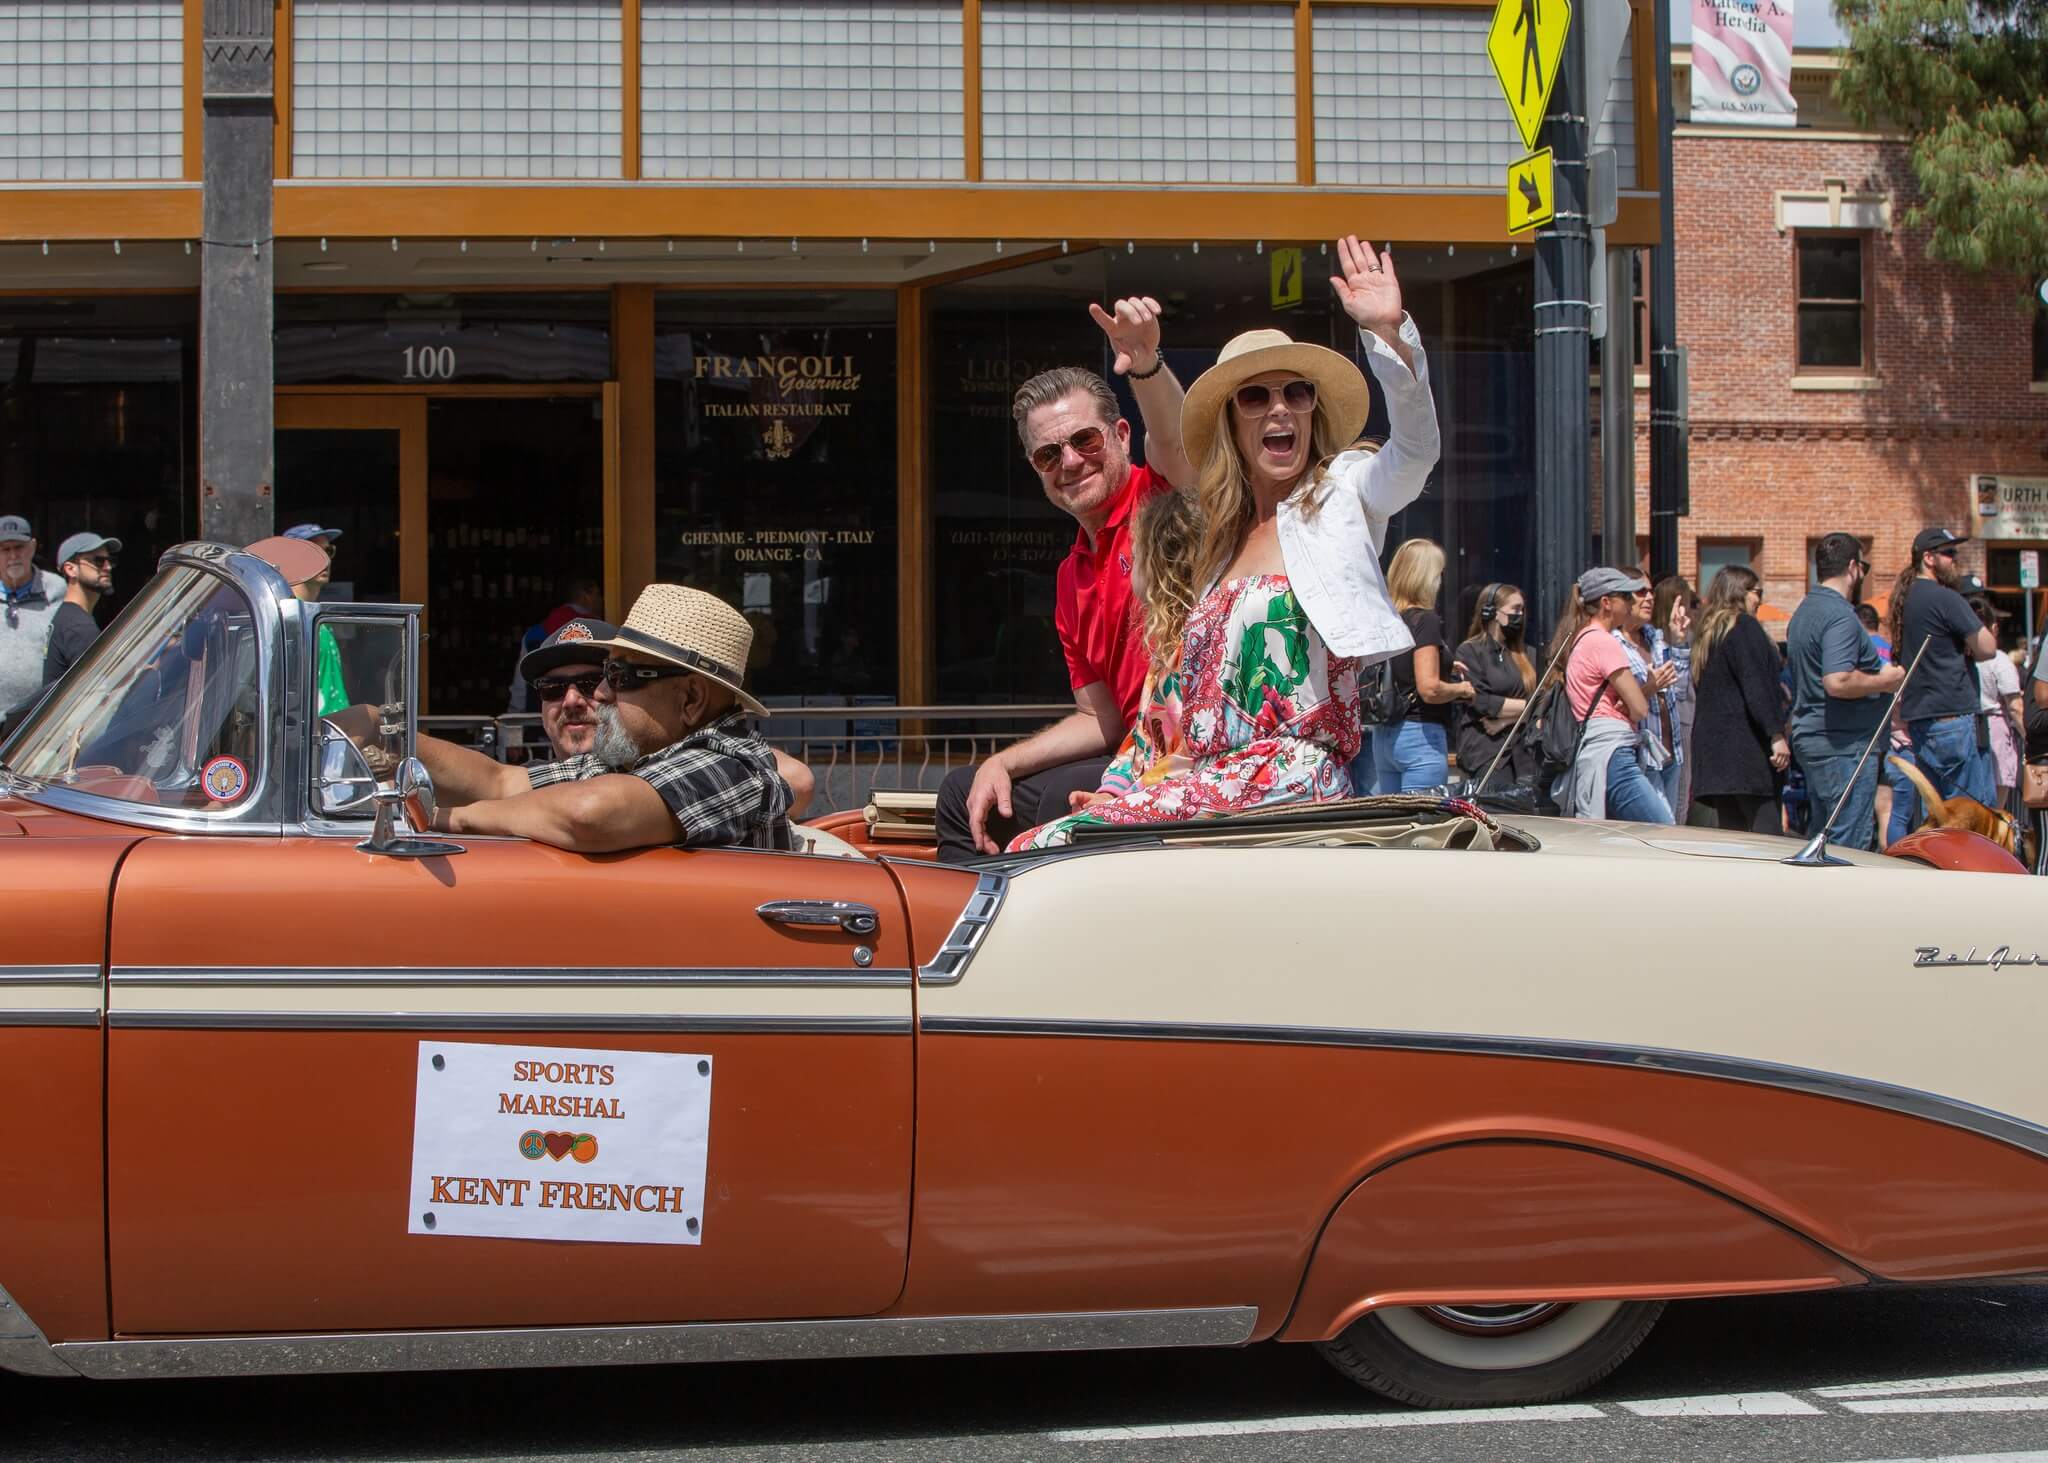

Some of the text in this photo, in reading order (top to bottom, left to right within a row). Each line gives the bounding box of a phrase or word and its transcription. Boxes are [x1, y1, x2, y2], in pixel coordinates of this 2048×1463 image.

[1740, 103, 1768, 113] NAVY
[402, 345, 456, 379] 100
[778, 373, 862, 397] Gourmet
[704, 403, 851, 418] ITALIAN RESTAURANT
[2003, 487, 2042, 503] URTH
[681, 531, 745, 545] GHEMME
[755, 531, 828, 544] PIEDMONT
[837, 531, 875, 544] ITALY
[734, 548, 793, 561] ORANGE
[803, 548, 823, 561] CA
[1913, 945, 1977, 968] Bel
[513, 1060, 615, 1086] SPORTS
[498, 1093, 625, 1119] MARSHAL
[430, 1175, 684, 1214] KENT FRENCH
